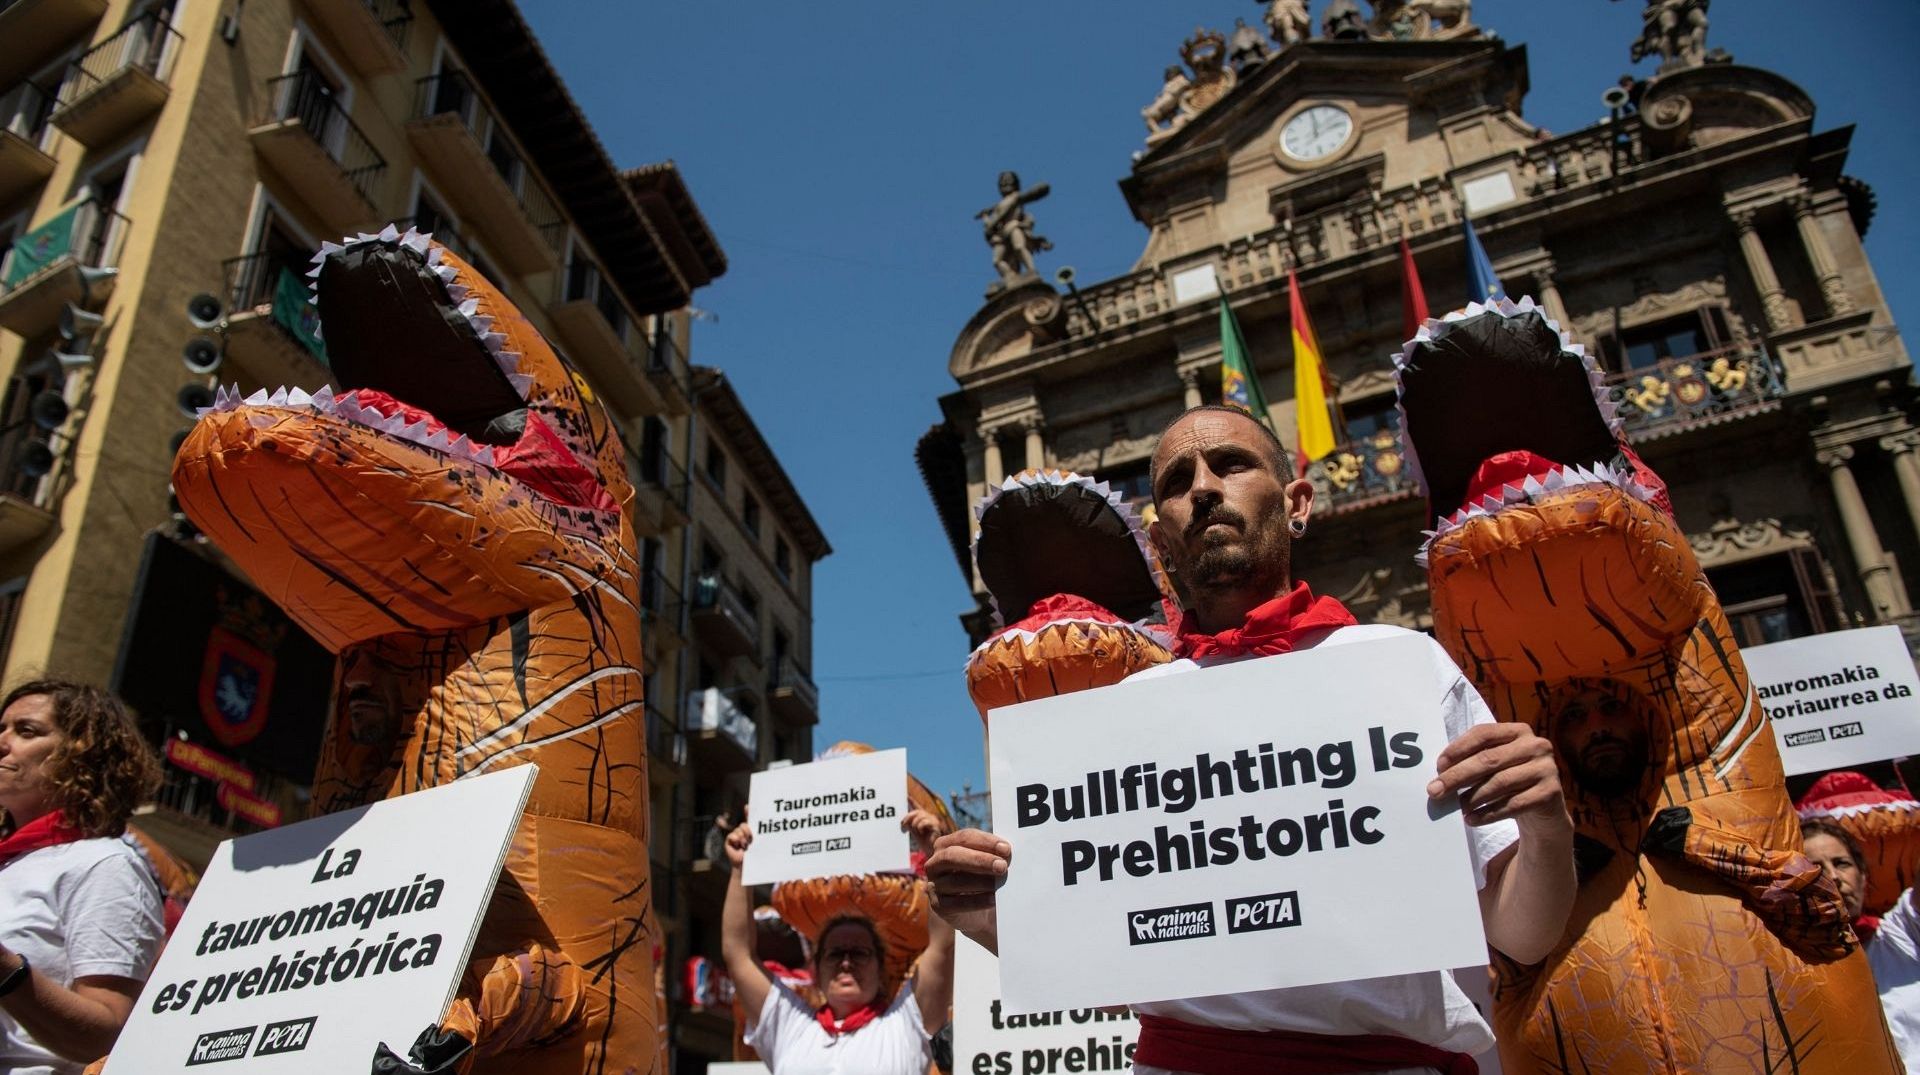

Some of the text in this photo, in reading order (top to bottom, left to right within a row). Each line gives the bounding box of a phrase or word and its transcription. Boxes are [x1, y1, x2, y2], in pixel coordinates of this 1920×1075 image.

[1757, 665, 1880, 699] auromakia
[1763, 683, 1912, 720] toriaurrea da
[1017, 726, 1424, 829] Bullfighting Is
[774, 785, 876, 813] Tauromakia
[757, 803, 896, 834] historiaurrea da
[1061, 799, 1385, 886] Prehistoric
[311, 847, 362, 884] La
[196, 873, 445, 957] tauromaquia
[1156, 909, 1209, 928] anima
[1158, 922, 1211, 939] naturalis
[152, 932, 443, 1016] es prehistórica
[206, 1044, 247, 1061] naturalis
[211, 1032, 252, 1050] anima
[971, 1051, 1013, 1075] es
